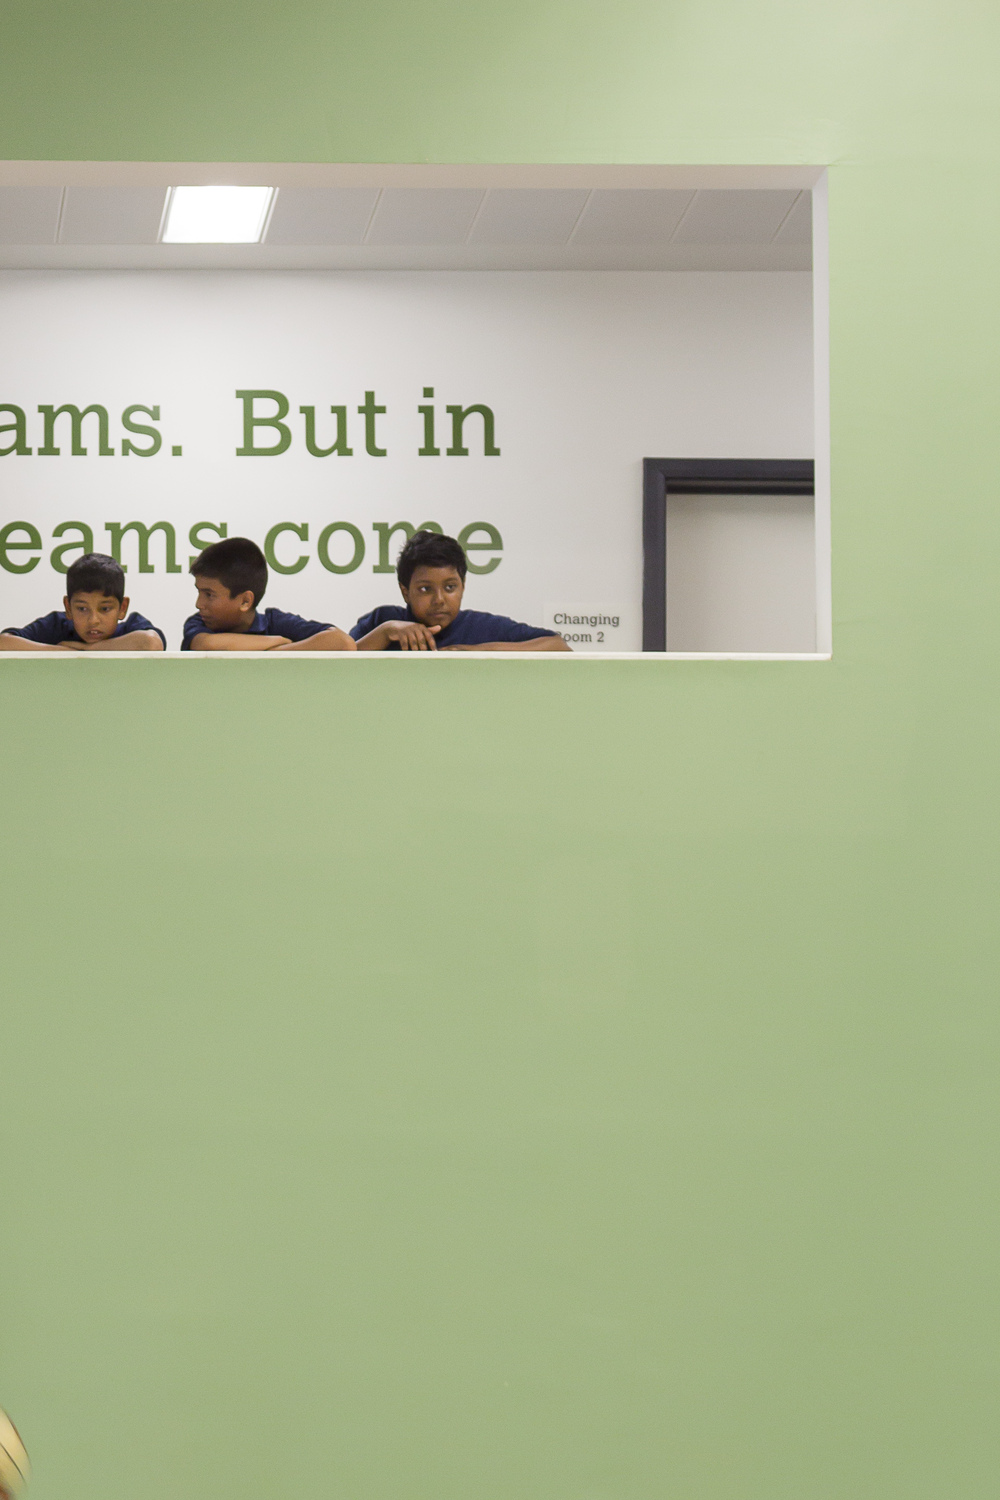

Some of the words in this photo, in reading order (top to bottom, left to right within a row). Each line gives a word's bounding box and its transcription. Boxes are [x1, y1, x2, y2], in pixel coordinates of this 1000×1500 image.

[235, 389, 388, 457] But
[417, 387, 501, 457] in
[553, 613, 620, 627] Changing
[597, 632, 604, 642] 2
